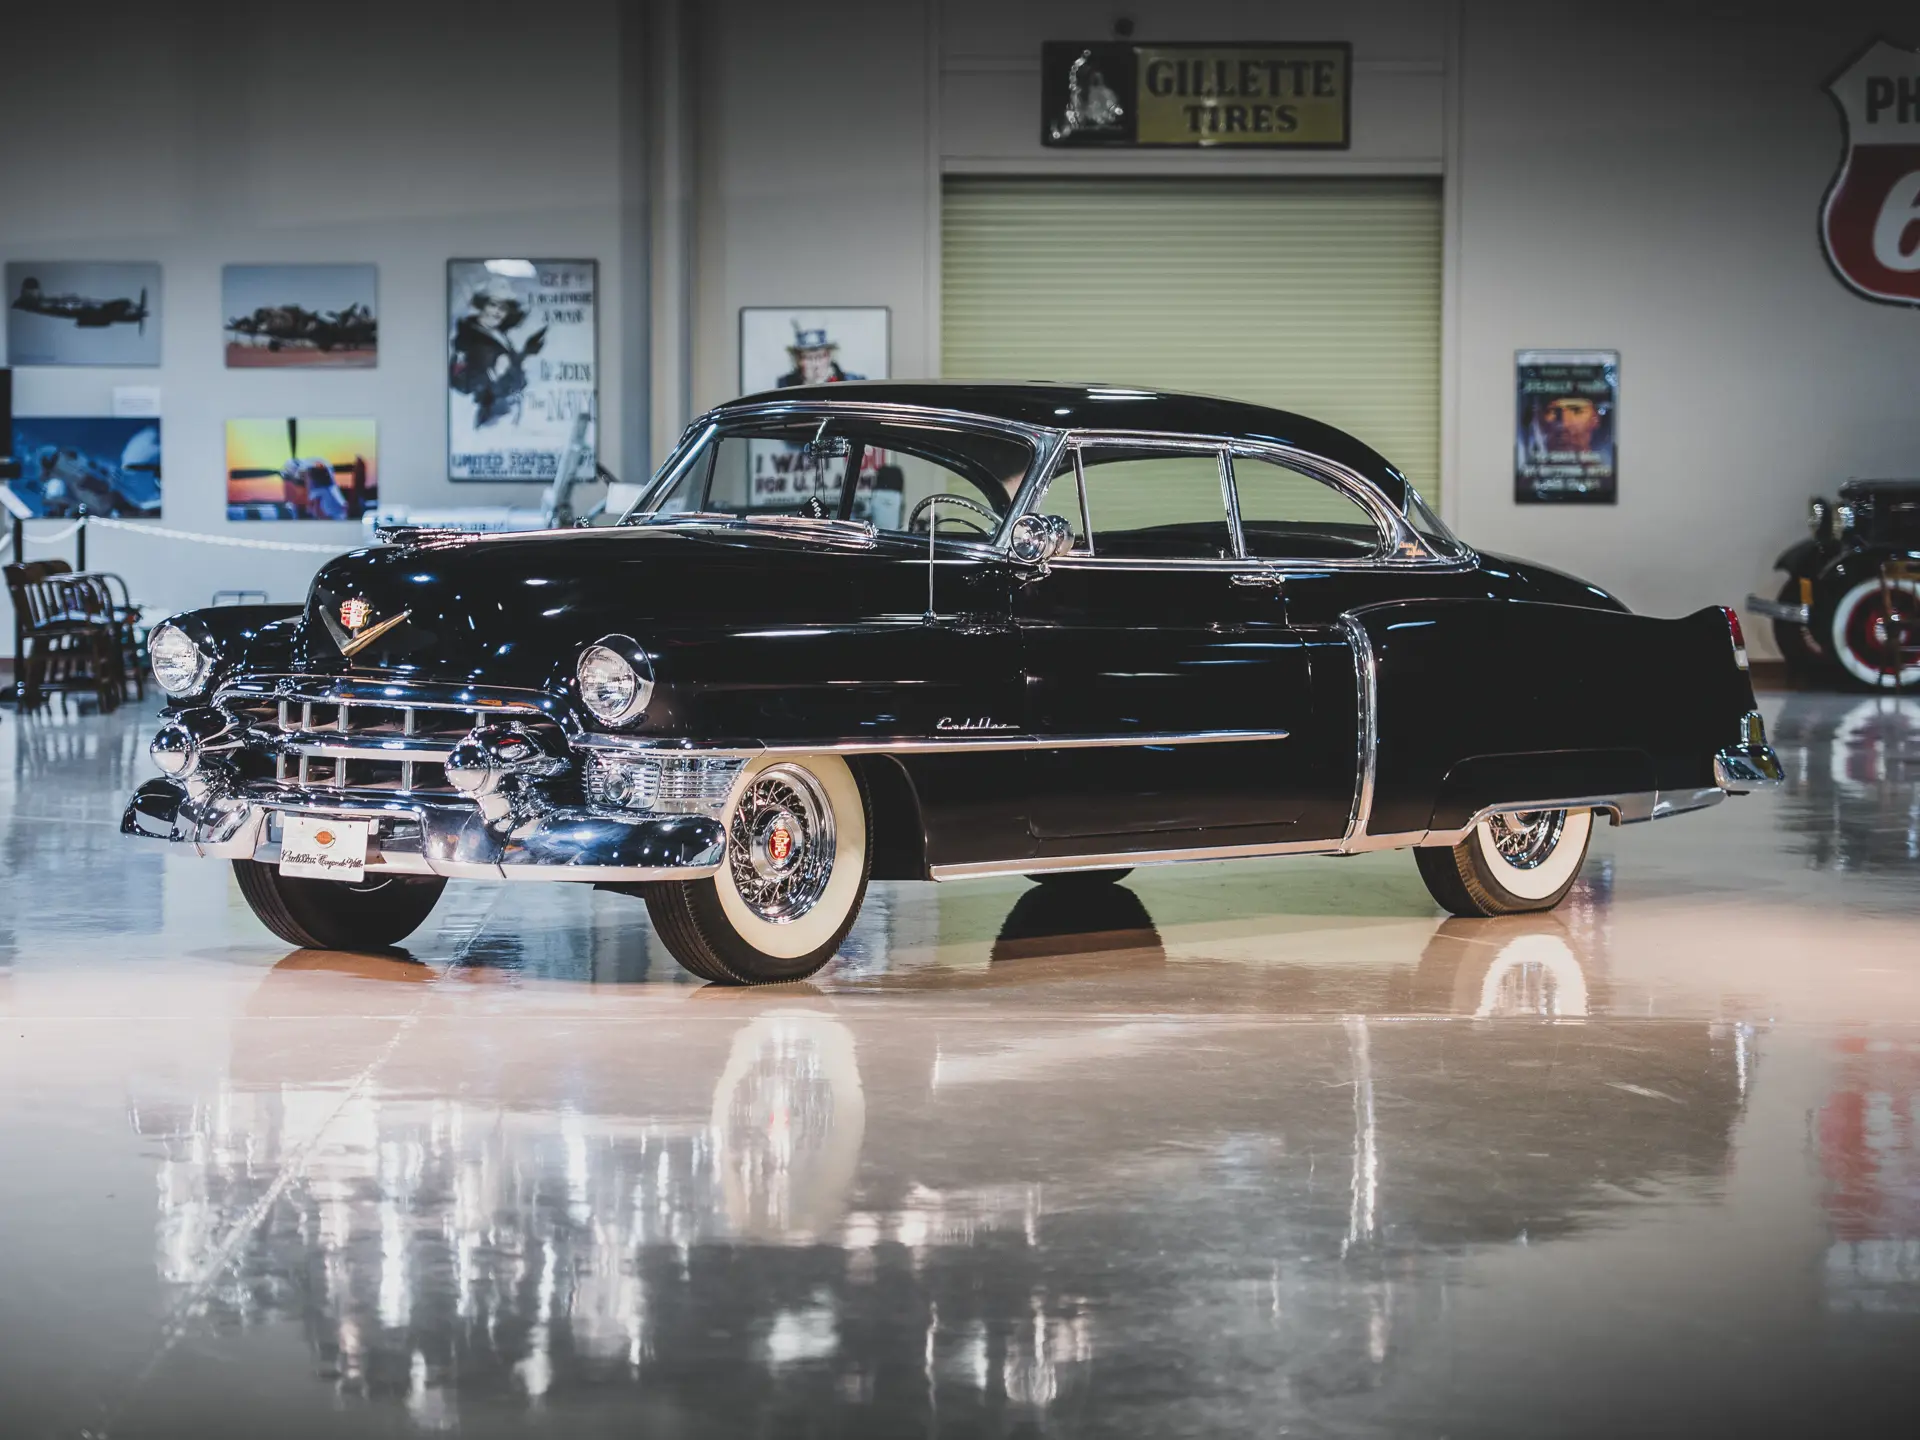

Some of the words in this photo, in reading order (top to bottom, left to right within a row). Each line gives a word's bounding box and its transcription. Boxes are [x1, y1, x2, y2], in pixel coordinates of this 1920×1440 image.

[1145, 59, 1336, 98] GILLETTE
[1182, 104, 1299, 133] TIRES
[555, 361, 592, 382] JOIN
[936, 716, 1020, 730] Cadillac
